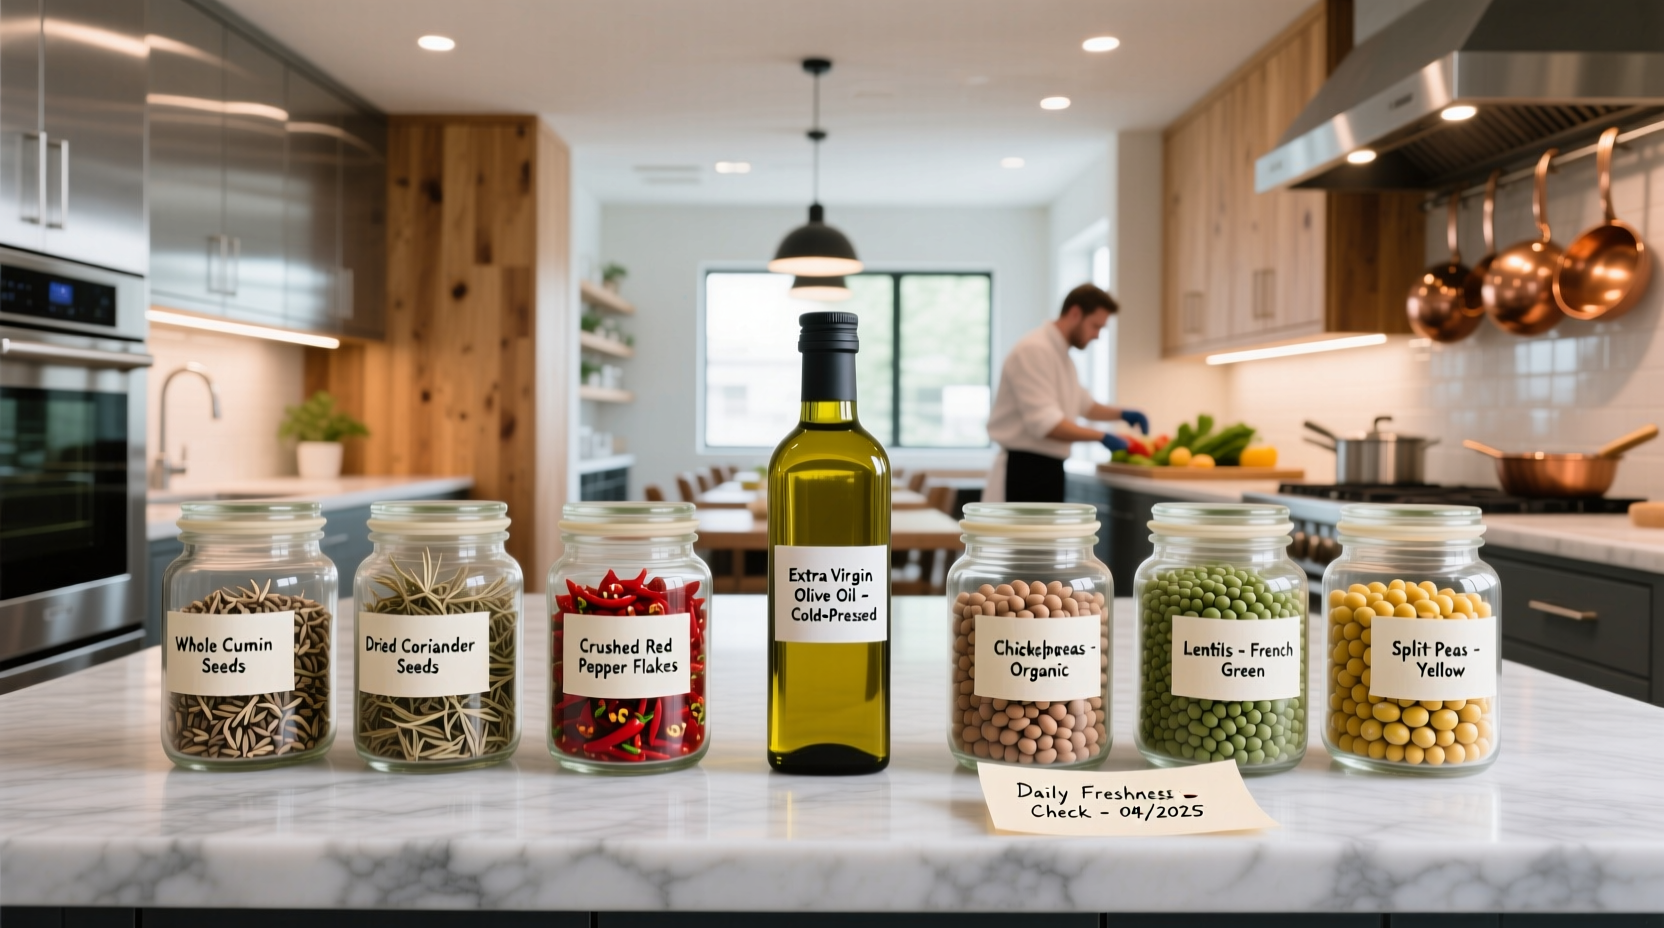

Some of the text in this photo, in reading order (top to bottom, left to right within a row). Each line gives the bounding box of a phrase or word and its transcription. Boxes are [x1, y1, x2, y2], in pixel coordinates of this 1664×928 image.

[789, 568, 872, 585] Extra Virgin
[795, 588, 830, 602] Olive
[837, 588, 855, 602] Oil
[791, 607, 876, 622] Cold-Pressed
[175, 636, 272, 653] Whole Cumin
[366, 636, 475, 653] Dried Coriander
[580, 638, 672, 654] Crushed Red
[1184, 641, 1233, 657] Lentils
[1251, 642, 1292, 657] French
[1392, 640, 1431, 662] Split
[1435, 642, 1468, 657] Peas
[202, 657, 245, 673] Seeds
[397, 658, 439, 674] Seeds
[579, 657, 677, 679] Pepper Flakes
[1011, 662, 1068, 682] Organic
[1222, 662, 1264, 677] Green
[1417, 662, 1465, 677] Yellow
[1017, 782, 1068, 804] Daily
[1082, 786, 1173, 800] Freshness
[1032, 803, 1091, 818] Check
[1120, 804, 1203, 821] 04/2025
